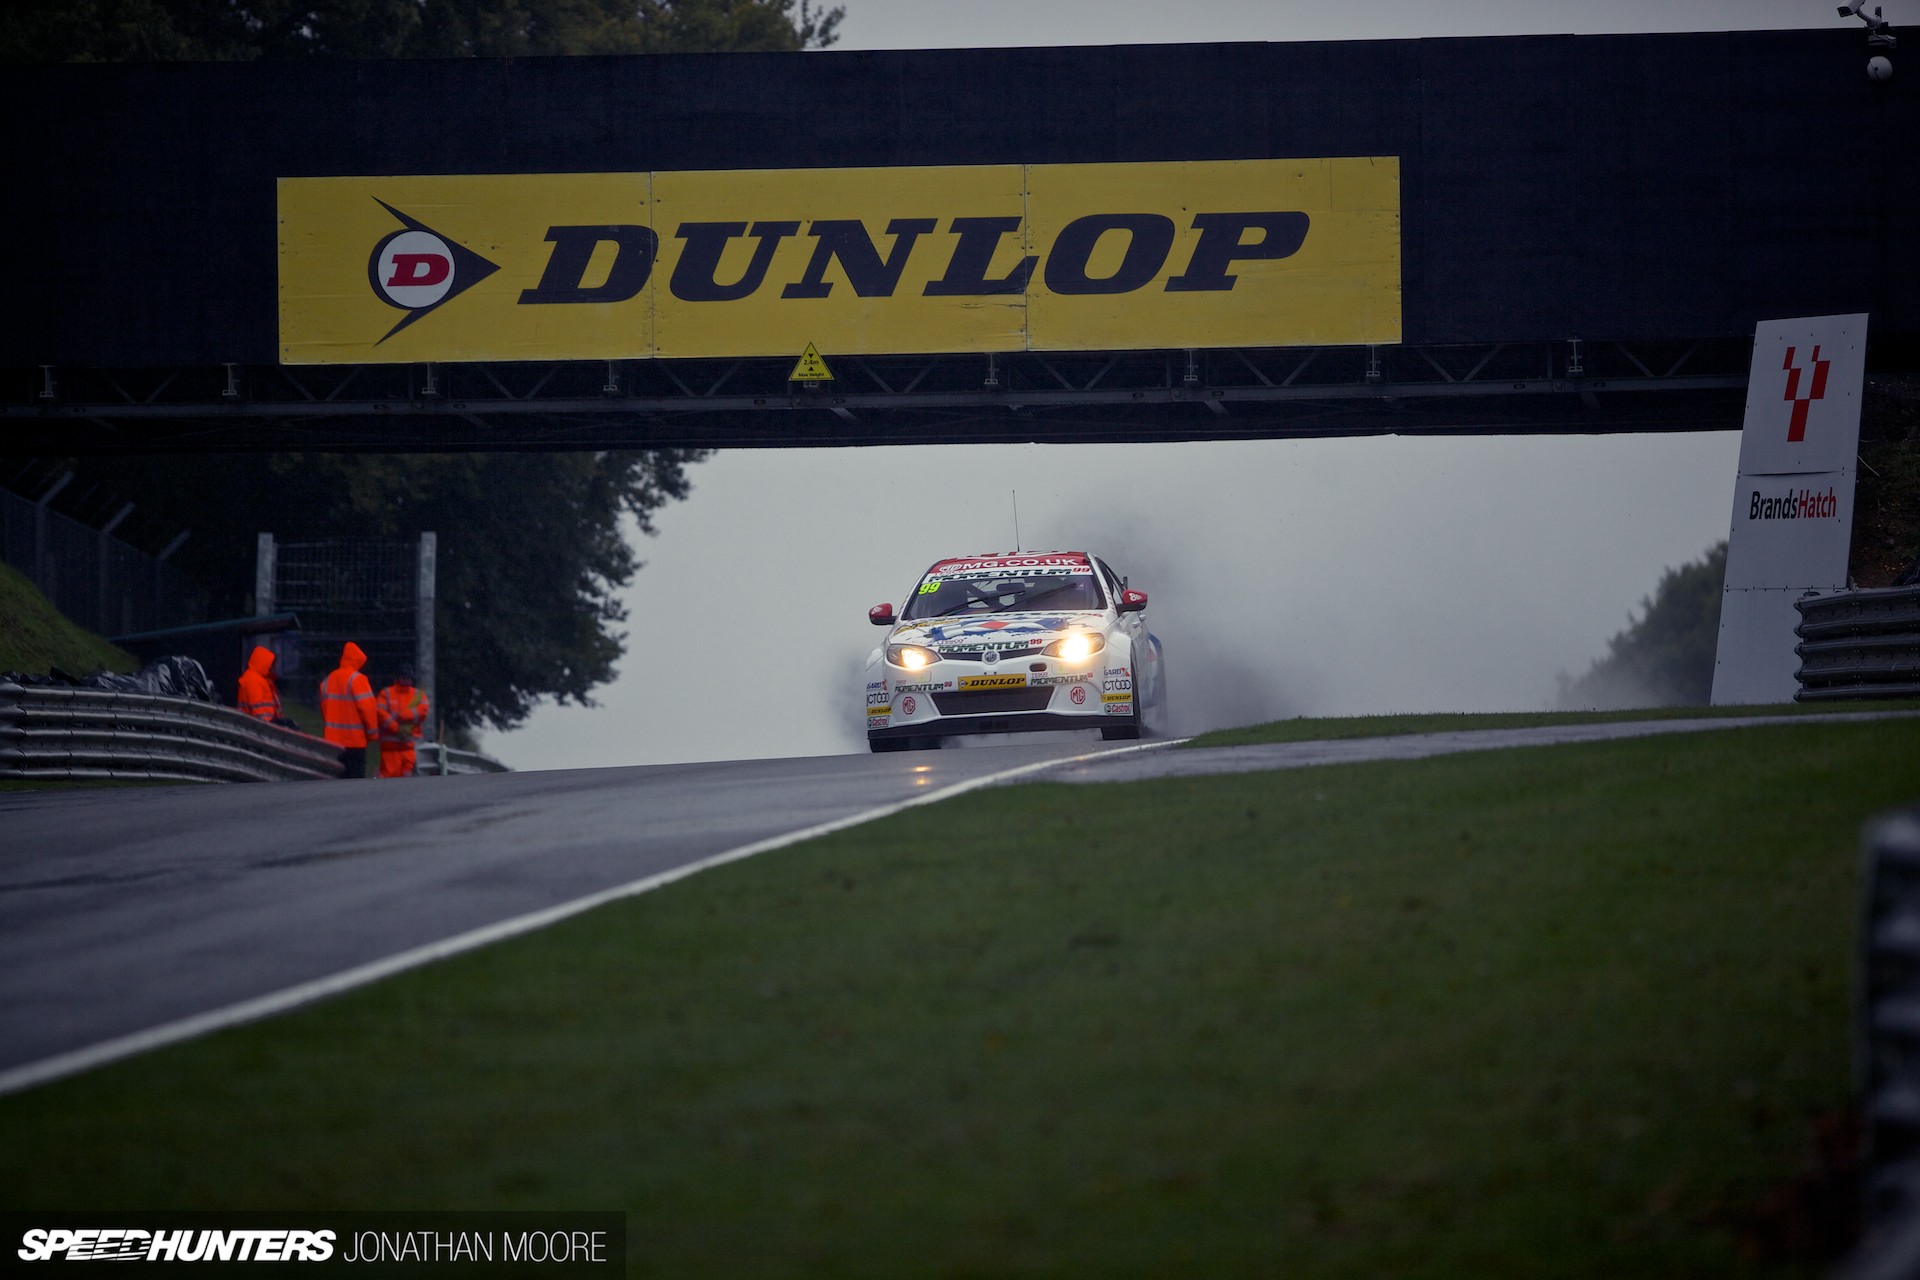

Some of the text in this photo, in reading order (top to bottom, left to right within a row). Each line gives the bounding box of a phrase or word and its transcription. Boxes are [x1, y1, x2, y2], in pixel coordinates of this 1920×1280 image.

[386, 211, 1311, 305] D DUNLOP
[1750, 486, 1838, 520] BrandsHatch
[918, 581, 941, 595] 99
[938, 641, 1029, 653] MOMENTUM
[970, 678, 1025, 687] DUNLOP
[1031, 674, 1088, 685] MOMENTUM
[895, 683, 944, 692] MOMENTUM
[1112, 703, 1130, 713] Castrol
